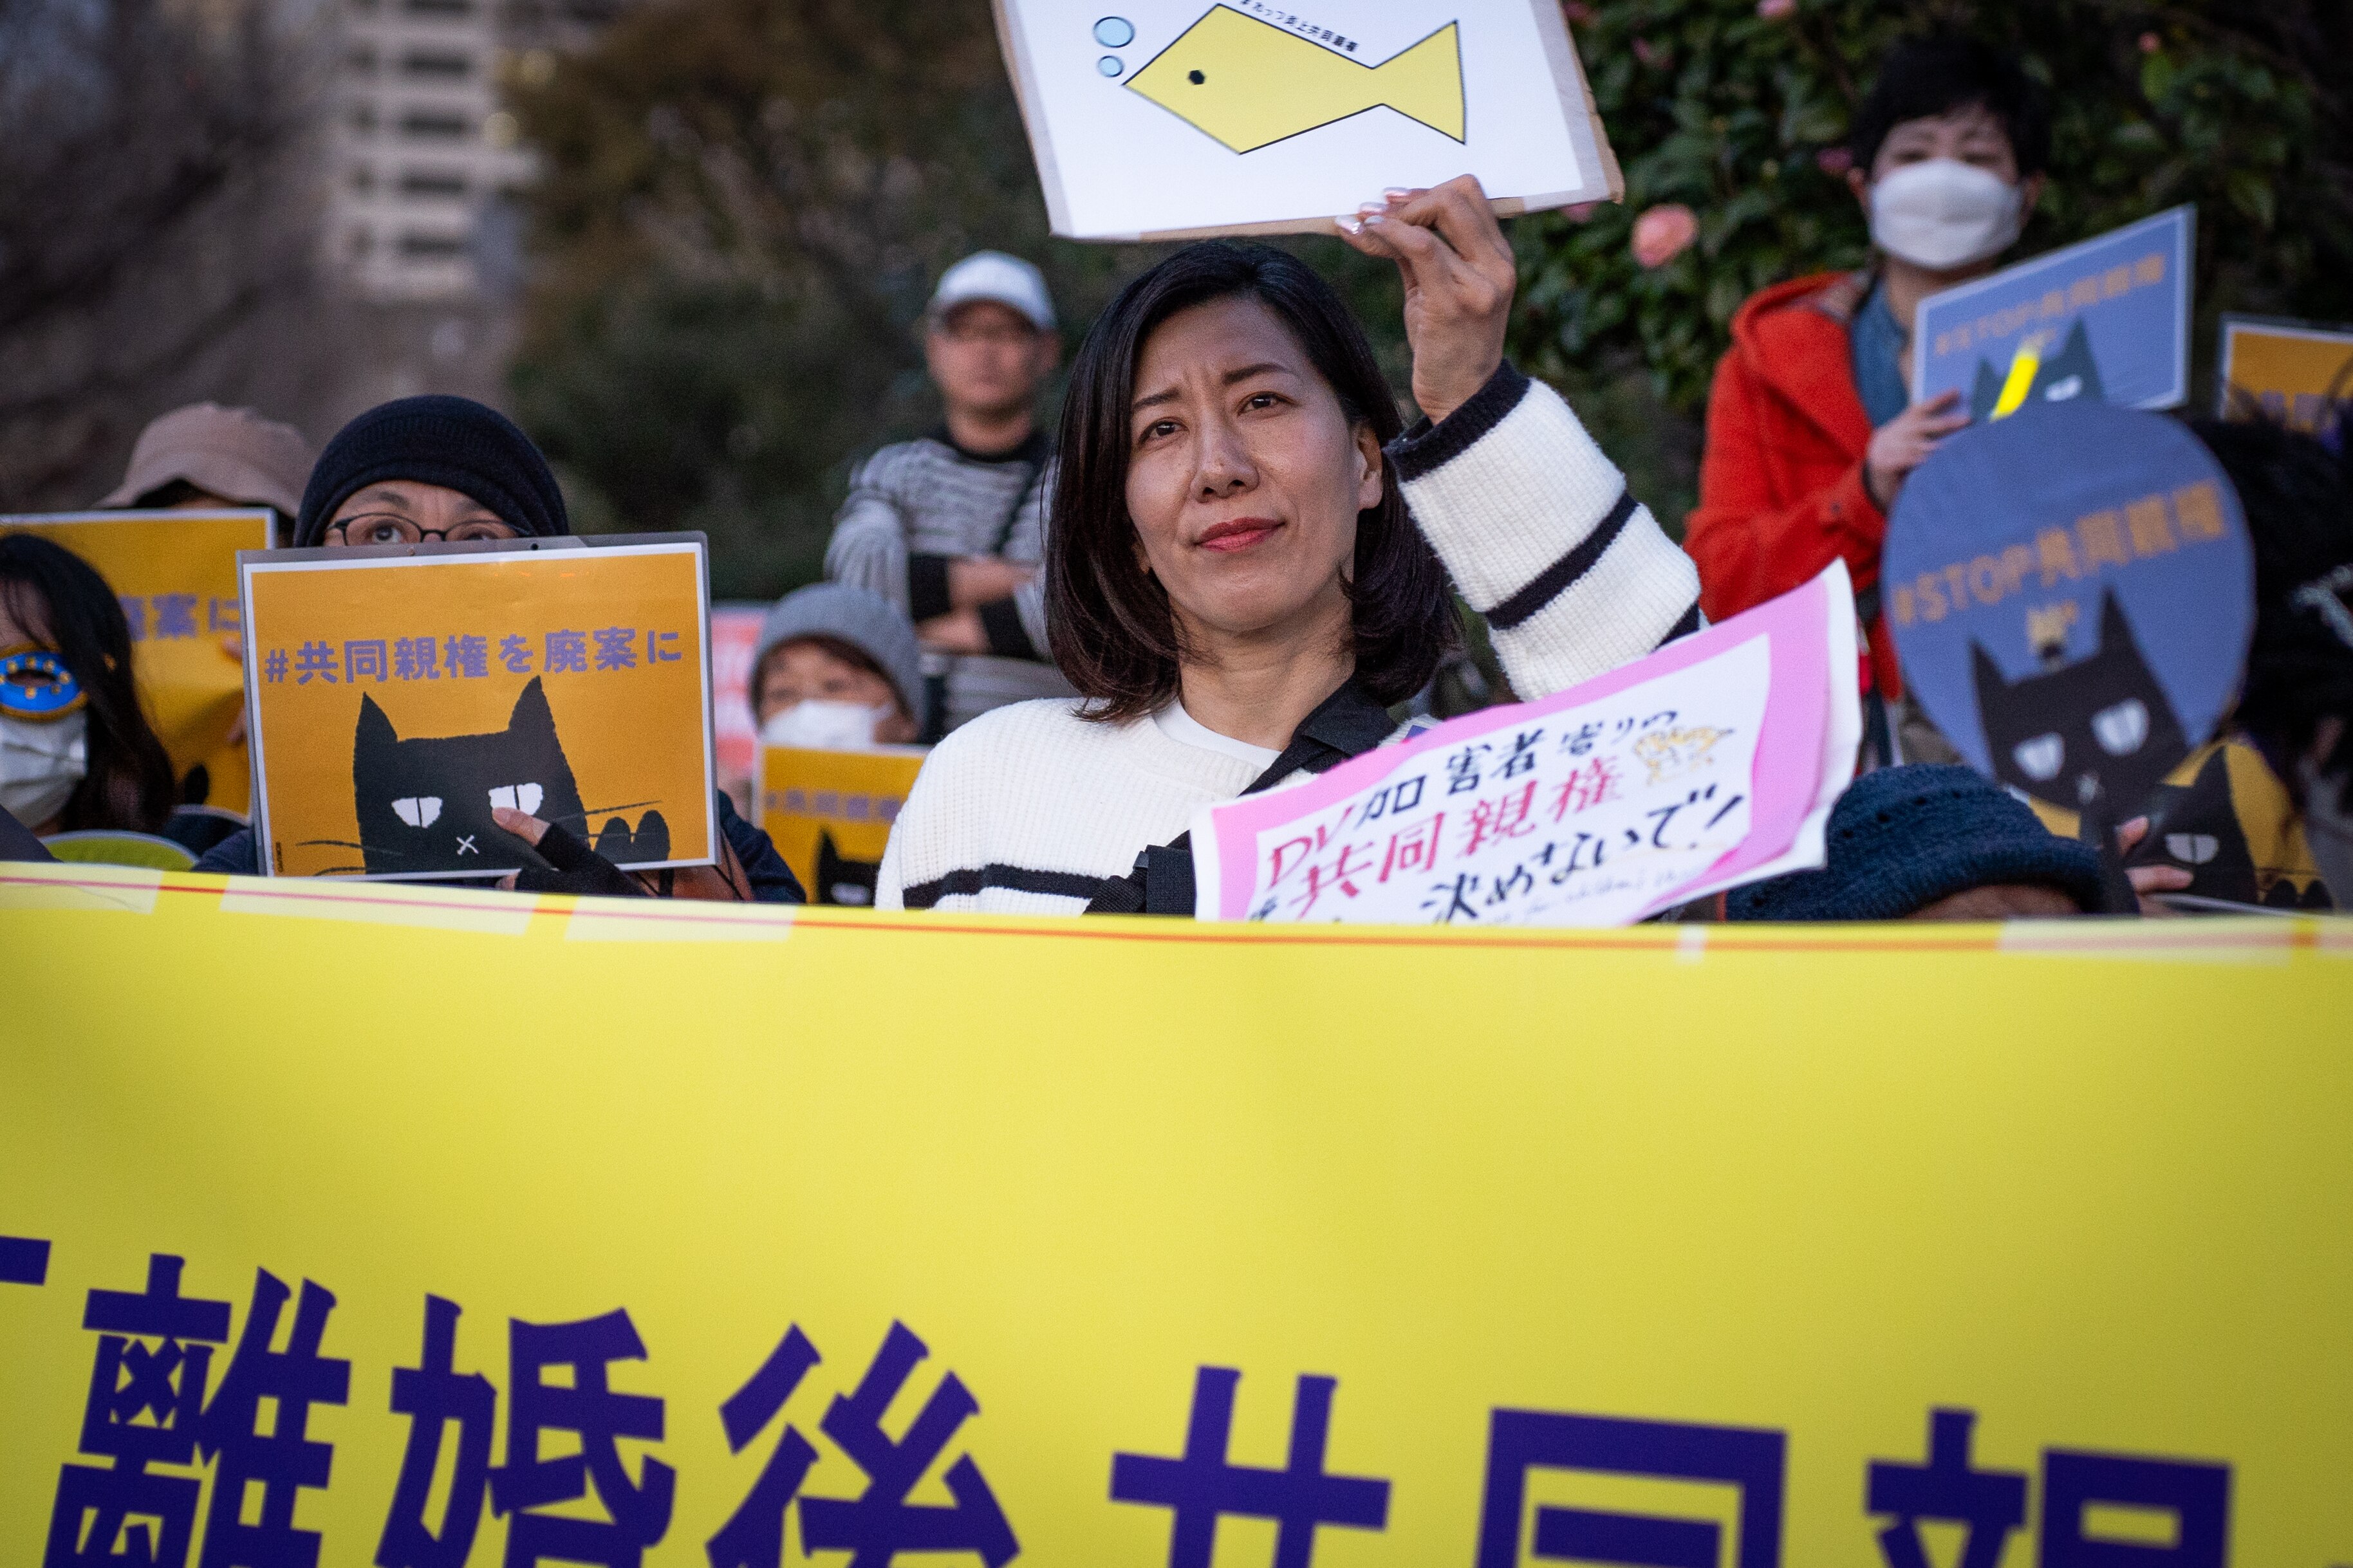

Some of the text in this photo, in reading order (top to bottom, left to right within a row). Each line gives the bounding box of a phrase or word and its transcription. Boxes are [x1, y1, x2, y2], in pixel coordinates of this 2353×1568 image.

[265, 626, 682, 685] #共同親権を廃案に
[1287, 758, 1624, 921] 共同親権
